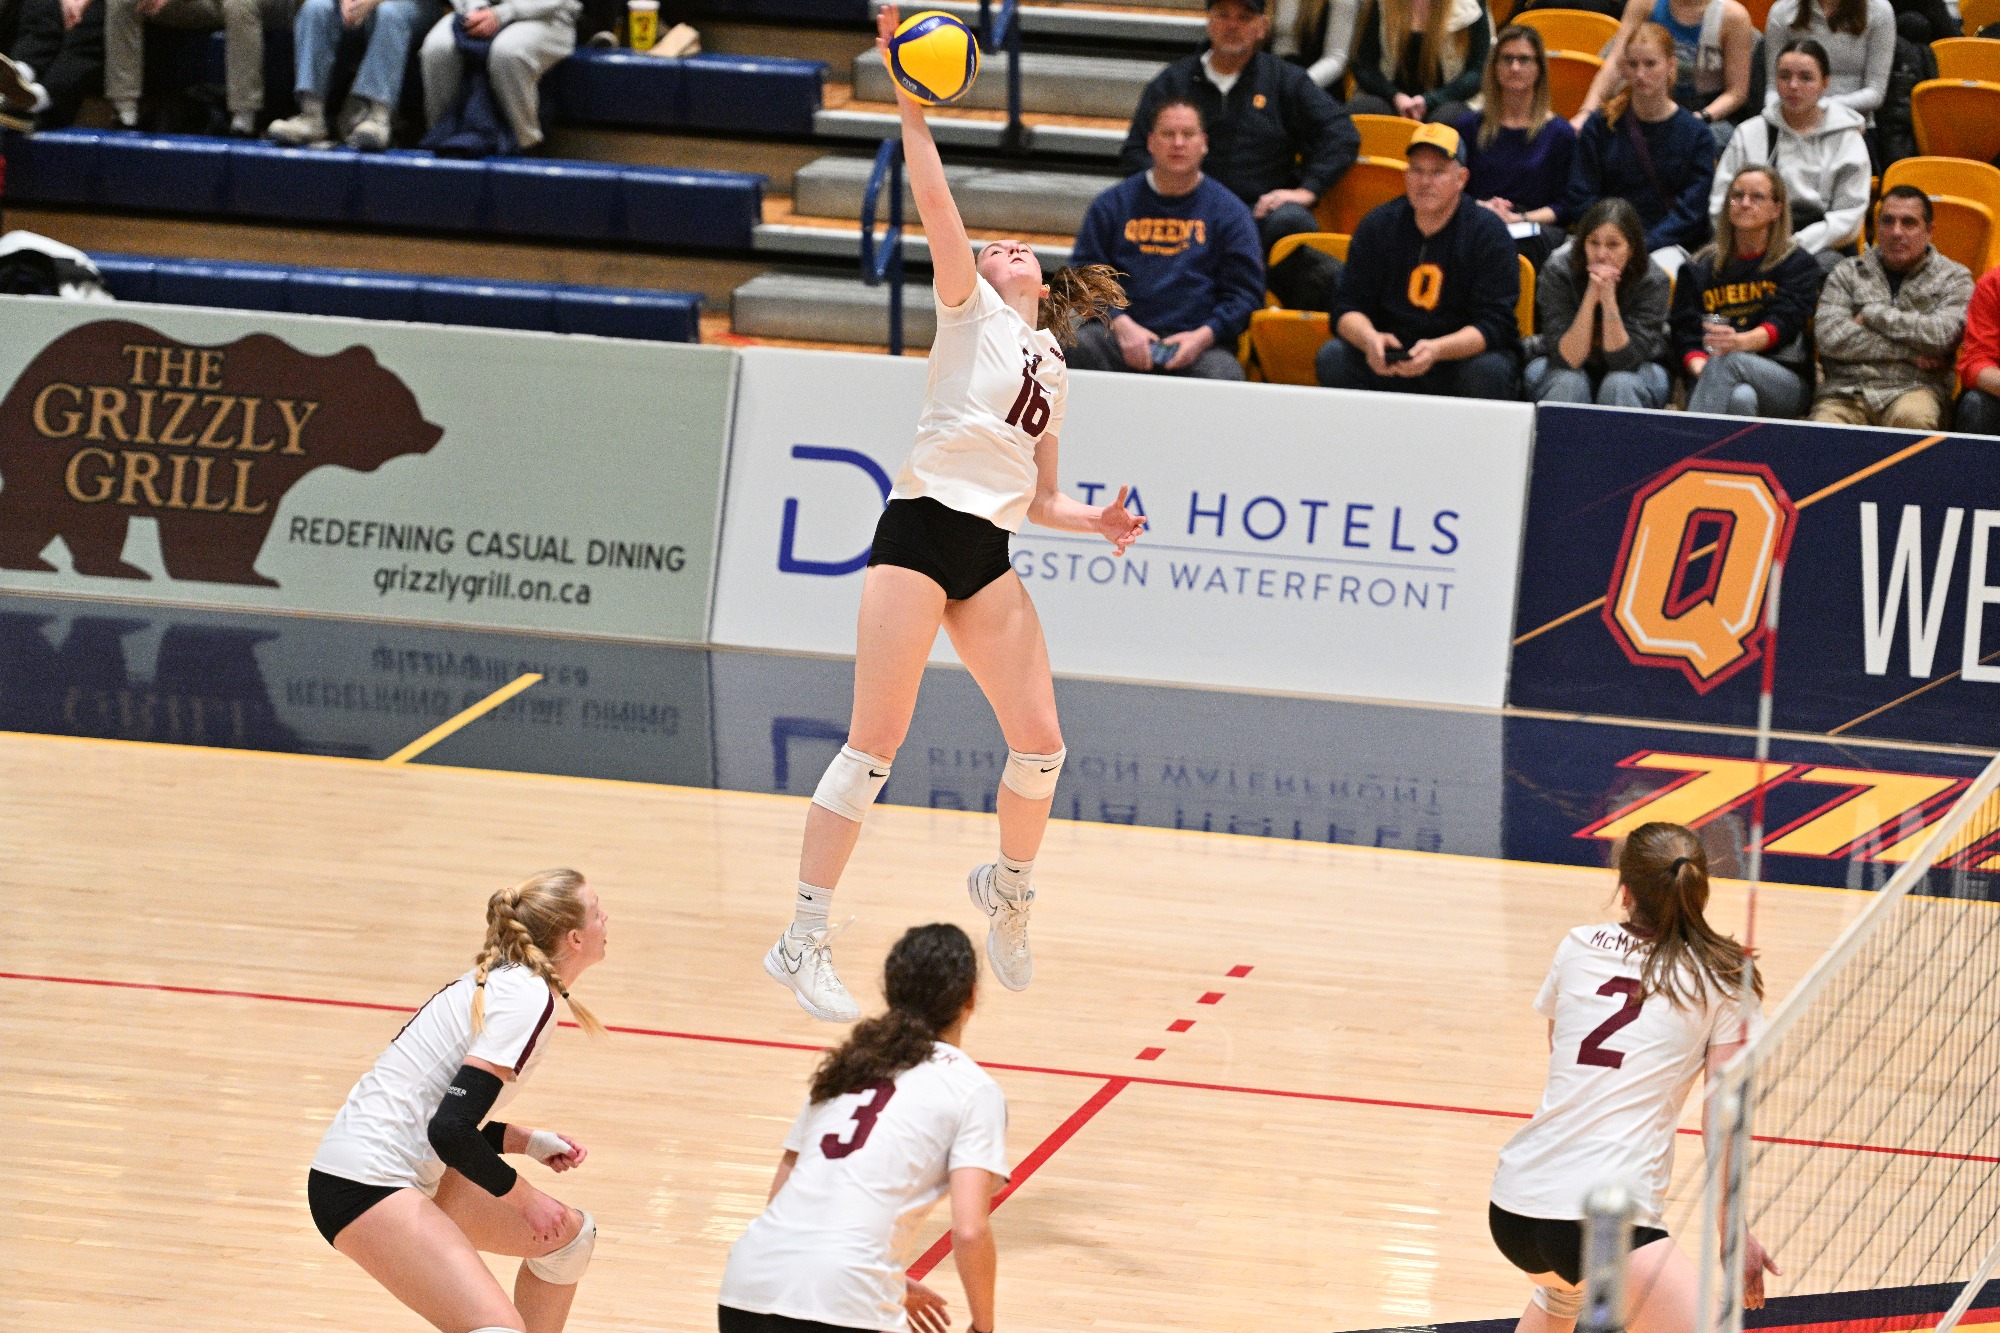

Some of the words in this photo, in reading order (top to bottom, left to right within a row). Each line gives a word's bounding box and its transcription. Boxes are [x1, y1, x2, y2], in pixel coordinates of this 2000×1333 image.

[1407, 262, 1444, 311] Q
[123, 344, 226, 391] THE
[32, 382, 319, 456] GRIZZLY
[1005, 368, 1051, 438] 16
[64, 447, 269, 515] GRILL
[288, 514, 456, 555] REDEFINING
[465, 528, 576, 566] CASUAL
[586, 537, 687, 573] DINING
[1187, 490, 1460, 555] HOTELS
[372, 562, 593, 605] grizzlygrill.on.ca
[1011, 549, 1149, 587] GSTON
[1169, 561, 1455, 611] WATERFRONT
[1602, 457, 1799, 697] Q
[1859, 500, 2000, 683] WE
[1576, 975, 1645, 1069] 2
[818, 1077, 897, 1160] 3
